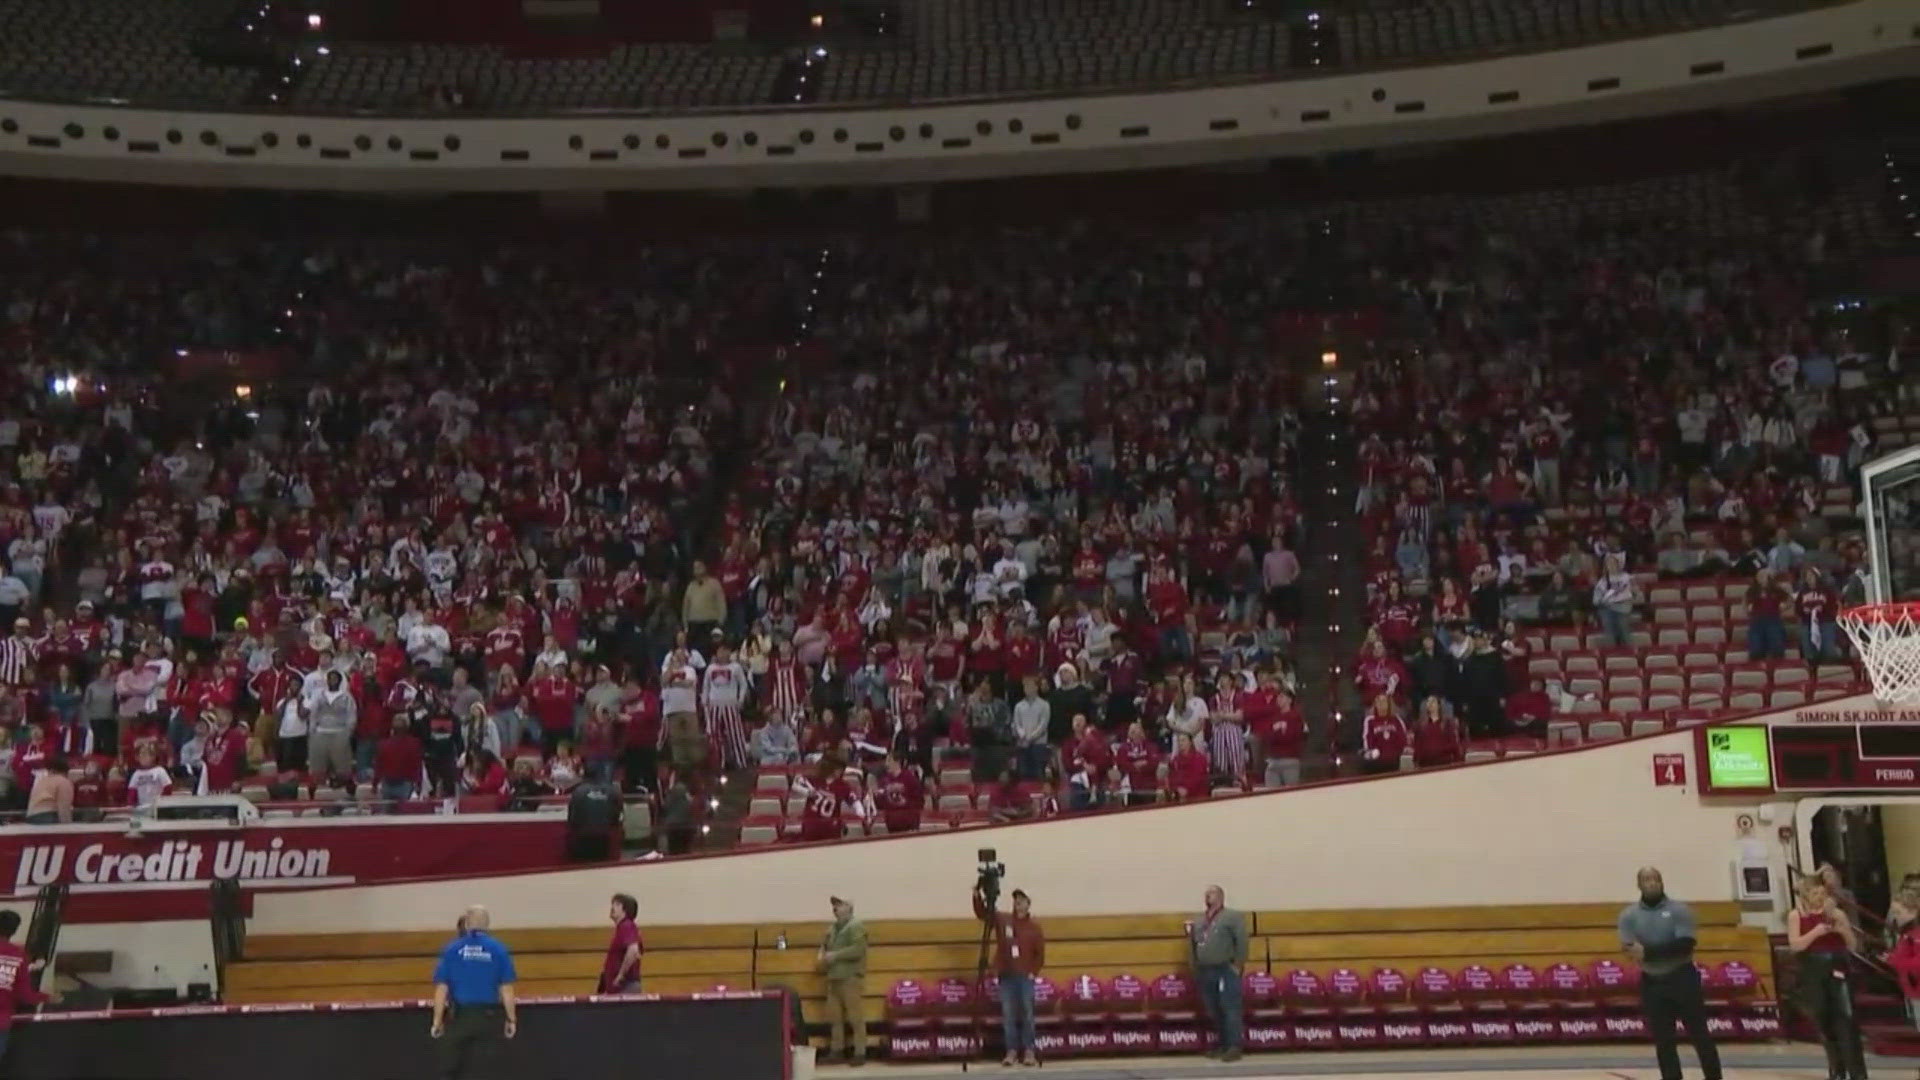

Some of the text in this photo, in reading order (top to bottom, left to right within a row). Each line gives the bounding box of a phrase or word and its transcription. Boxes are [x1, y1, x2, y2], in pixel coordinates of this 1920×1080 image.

[1796, 710, 1920, 723] SIMON SKJODT AS
[1665, 764, 1676, 782] 4
[1875, 768, 1915, 781] PERIOD
[15, 837, 330, 885] IU Credit Union
